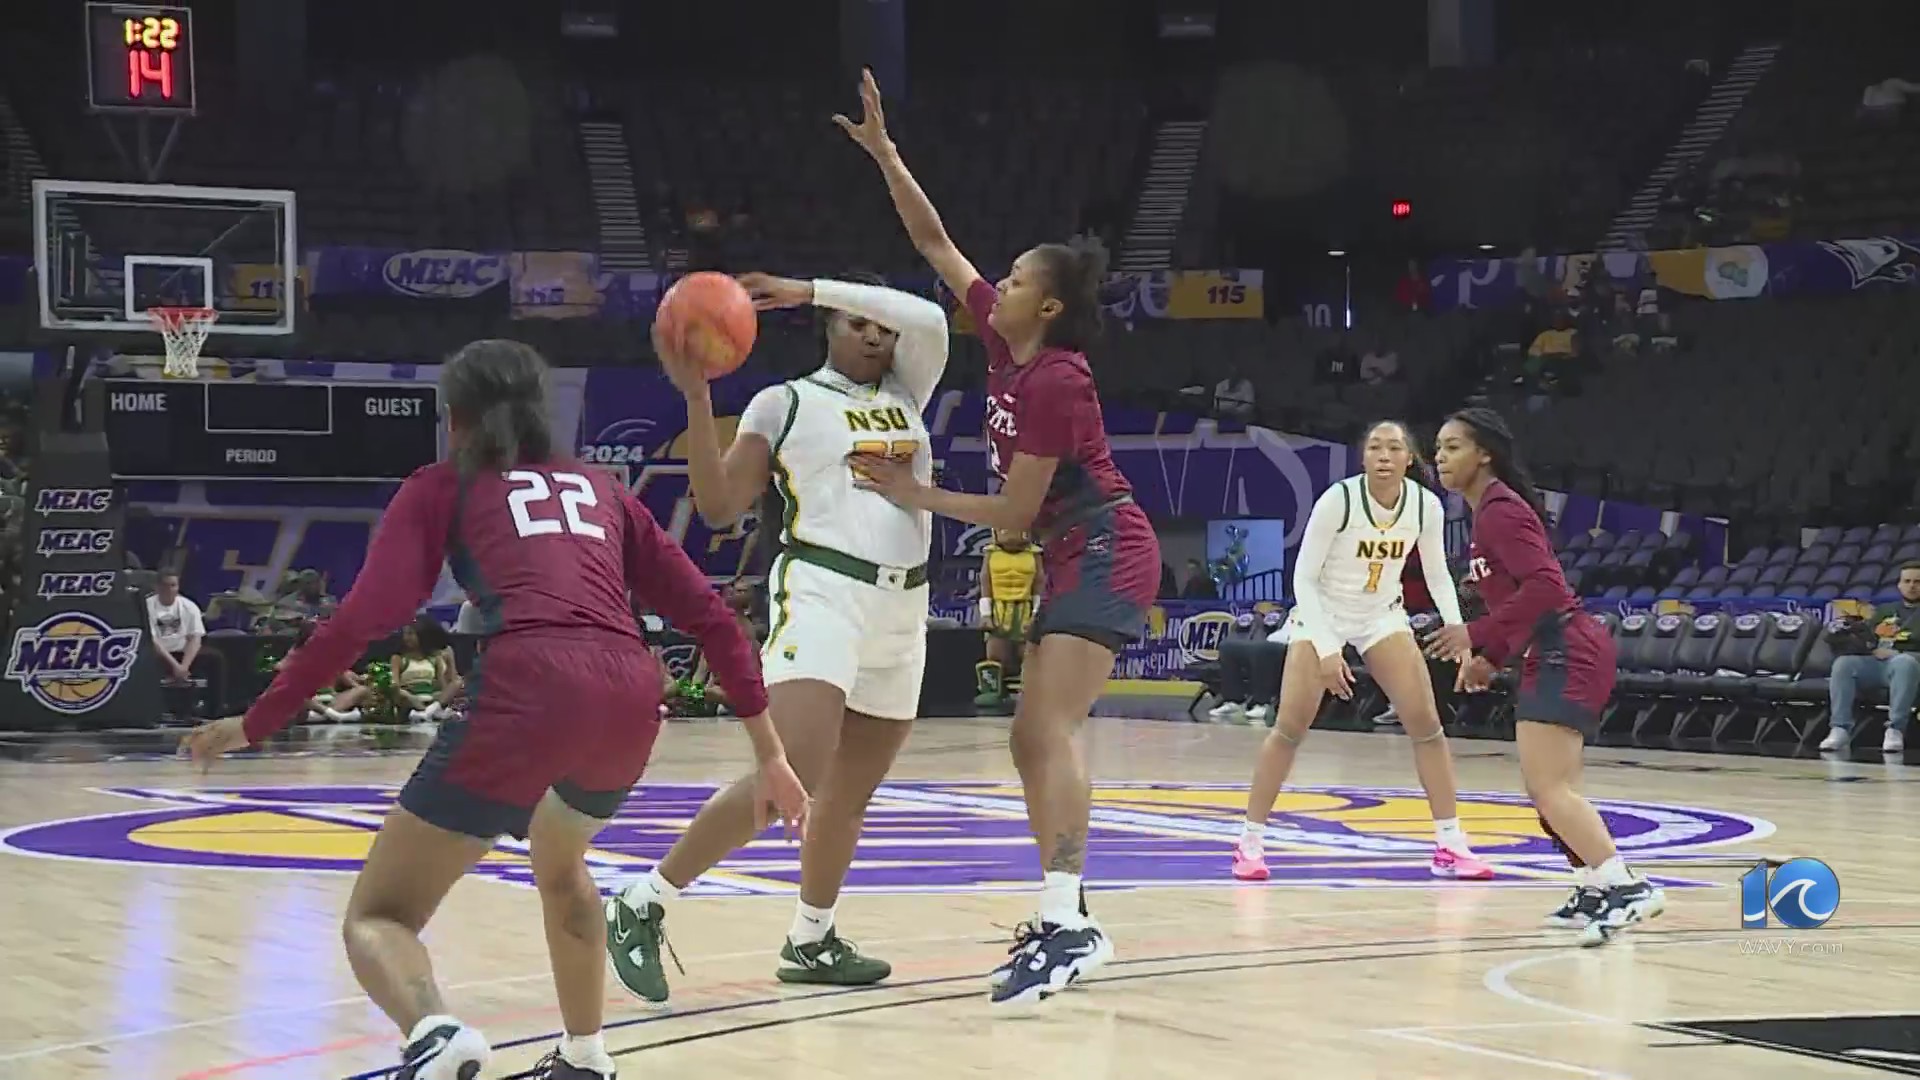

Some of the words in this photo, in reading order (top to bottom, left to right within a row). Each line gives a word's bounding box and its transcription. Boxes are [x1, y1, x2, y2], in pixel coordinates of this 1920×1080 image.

[124, 17, 180, 49] 1:22
[129, 49, 172, 97] 14
[399, 256, 498, 286] MEAC
[1207, 285, 1246, 304] 115
[111, 392, 168, 412] HOME
[364, 397, 423, 417] GUEST
[844, 407, 910, 433] NSU
[225, 448, 277, 463] PERIOD
[580, 445, 642, 463] 2024
[36, 489, 113, 514] MEAC
[502, 470, 606, 541] 22
[37, 530, 114, 556] MEAC
[1356, 540, 1405, 560] NSU
[38, 572, 116, 598] MEAC
[1364, 561, 1384, 593] 1
[1186, 621, 1230, 651] MEA
[13, 634, 137, 675] MEAC
